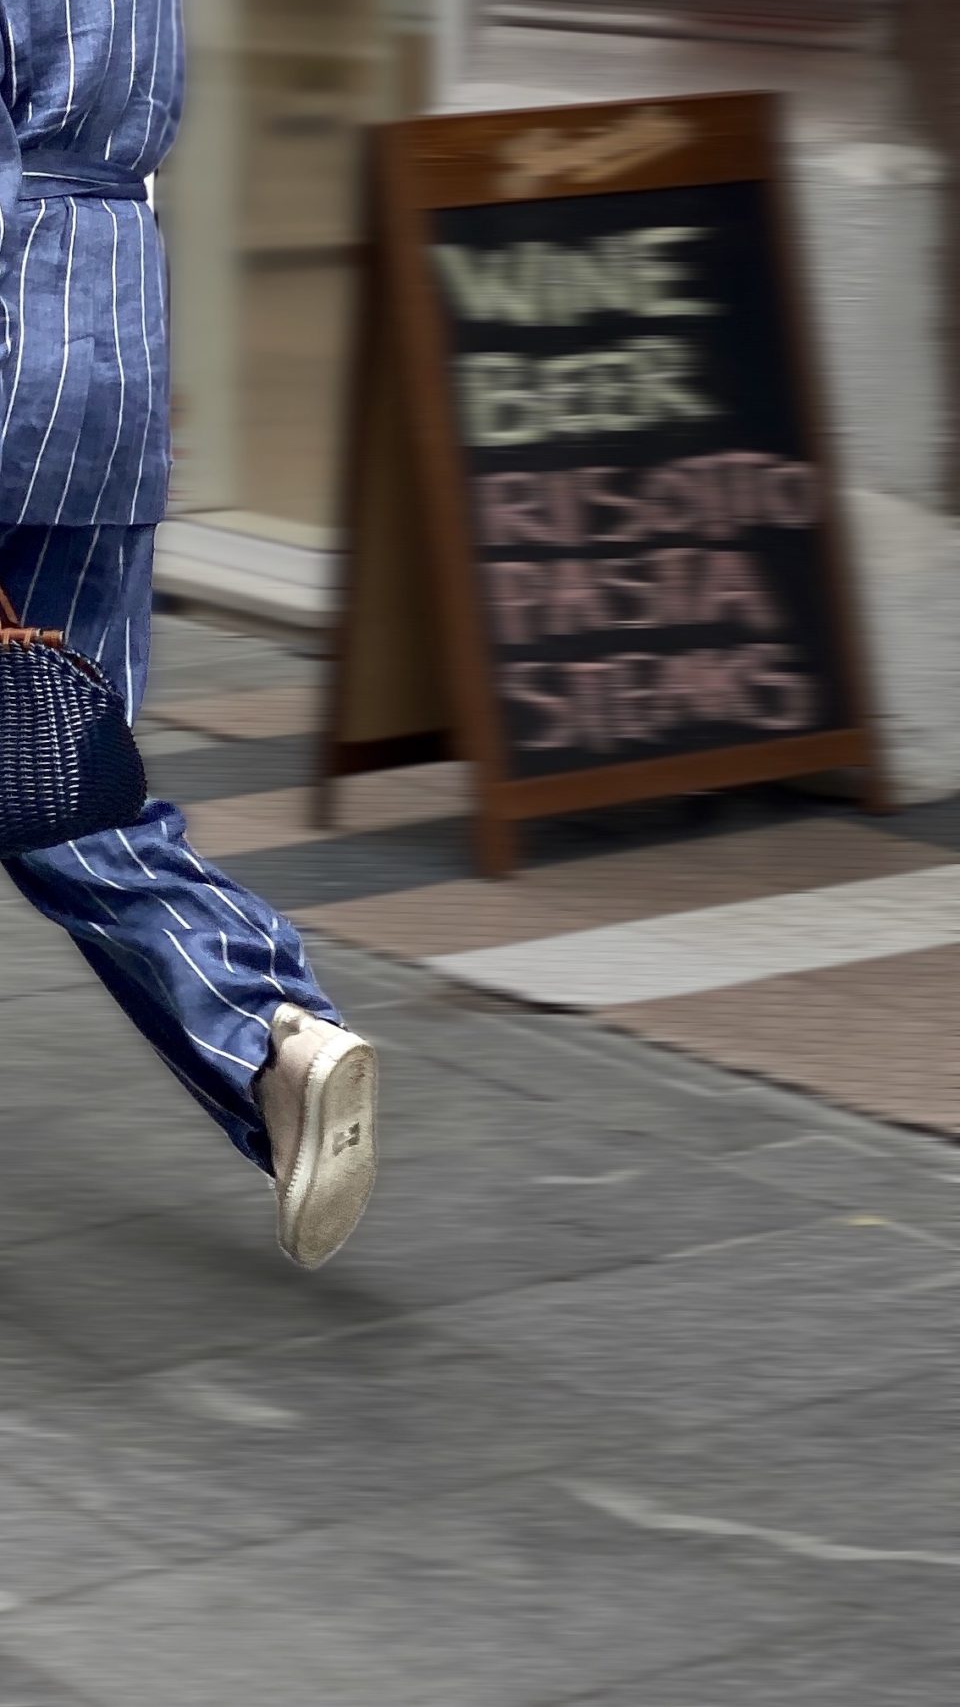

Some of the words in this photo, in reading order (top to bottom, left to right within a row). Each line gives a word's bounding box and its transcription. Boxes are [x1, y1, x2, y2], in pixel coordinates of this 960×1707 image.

[432, 226, 720, 326] WINE
[458, 336, 724, 446] BEER
[486, 548, 782, 644] PASTA
[500, 644, 816, 752] STEAKS
